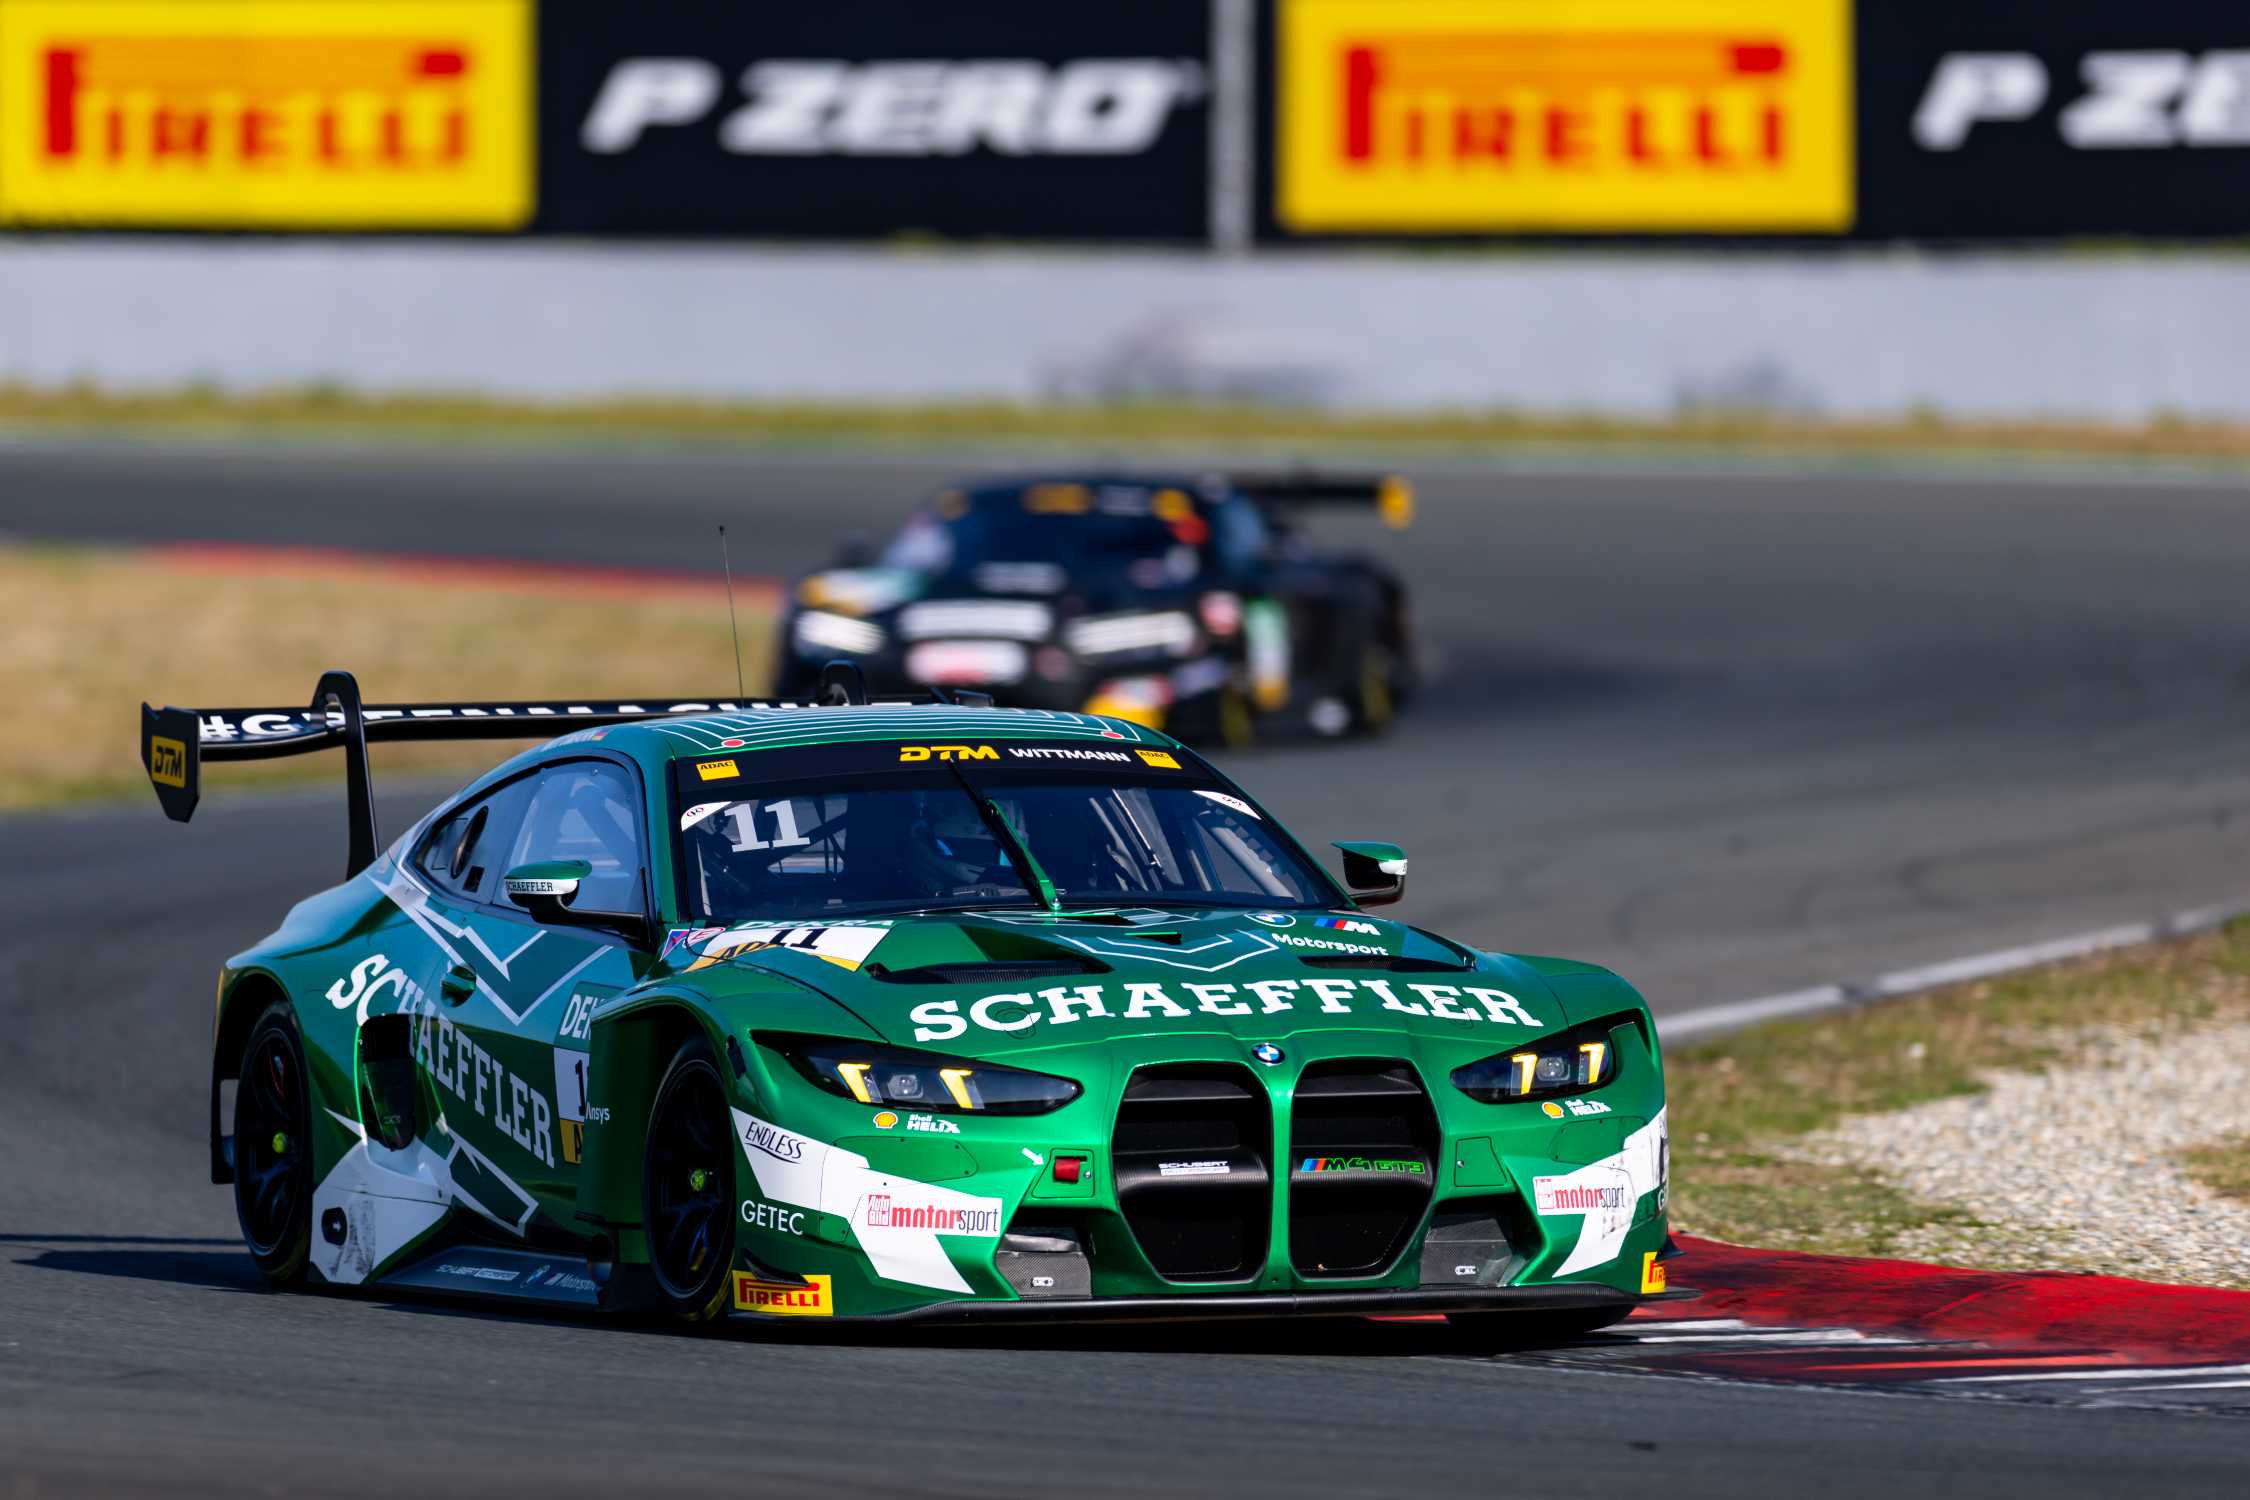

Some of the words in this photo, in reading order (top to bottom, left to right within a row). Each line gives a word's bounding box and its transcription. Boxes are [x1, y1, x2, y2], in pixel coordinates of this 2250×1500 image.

[42, 40, 470, 163] PIRELLI
[580, 57, 723, 153] P
[717, 58, 1180, 155] ZERO
[1340, 36, 1790, 167] PIRELLI
[1911, 52, 2048, 150] P
[2057, 50, 2250, 149] ZE
[154, 745, 183, 779] DTM
[700, 761, 734, 770] ADAC
[899, 745, 1001, 762] DTM
[1008, 747, 1131, 762] WITTMANN
[723, 800, 811, 852] 11
[767, 927, 830, 950] 11
[1271, 932, 1390, 956] Motorsport
[909, 979, 1545, 1042] SCHAEFFLER
[585, 1101, 611, 1125] Ansys
[906, 1119, 961, 1134] HELIX
[745, 1120, 808, 1161] ENDLESS
[1554, 1184, 1626, 1211] motorsport
[741, 1200, 804, 1236] GETEC
[891, 1205, 999, 1234] motorsport
[738, 1277, 821, 1307] PIRELLI
